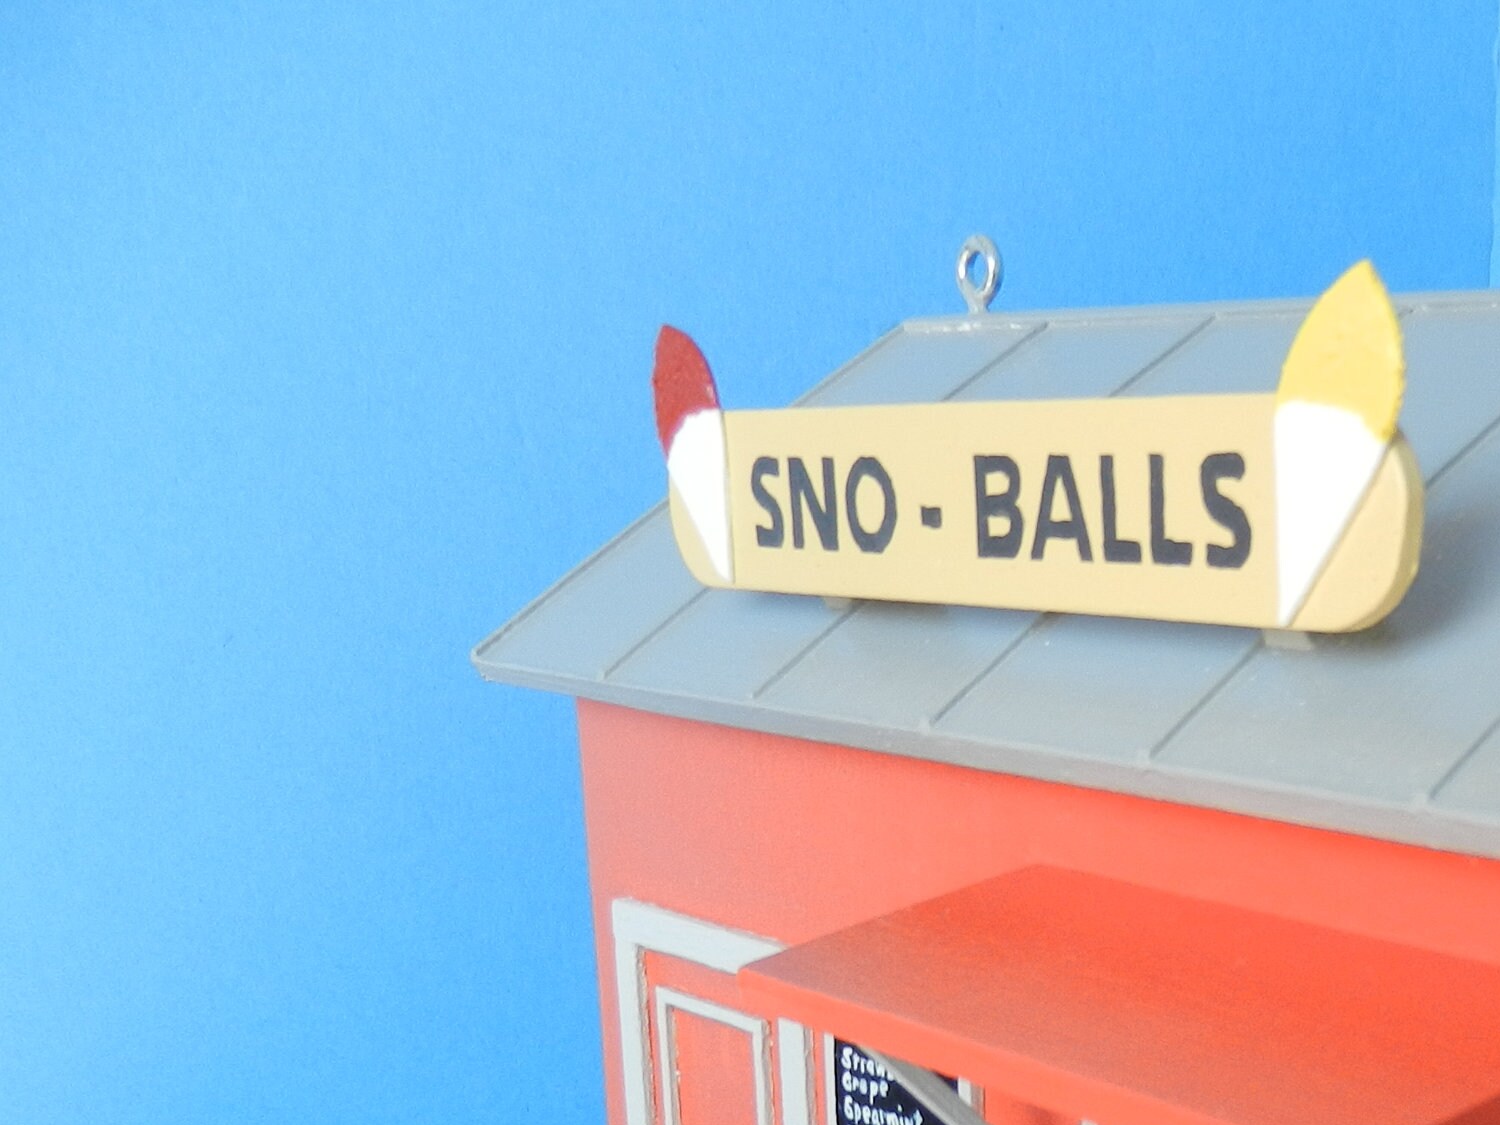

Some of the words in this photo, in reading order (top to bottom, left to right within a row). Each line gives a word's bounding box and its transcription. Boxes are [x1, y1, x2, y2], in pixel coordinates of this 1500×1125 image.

[751, 456, 897, 553] SNO
[973, 452, 1252, 569] BALLS
[842, 1071, 889, 1105] Grape
